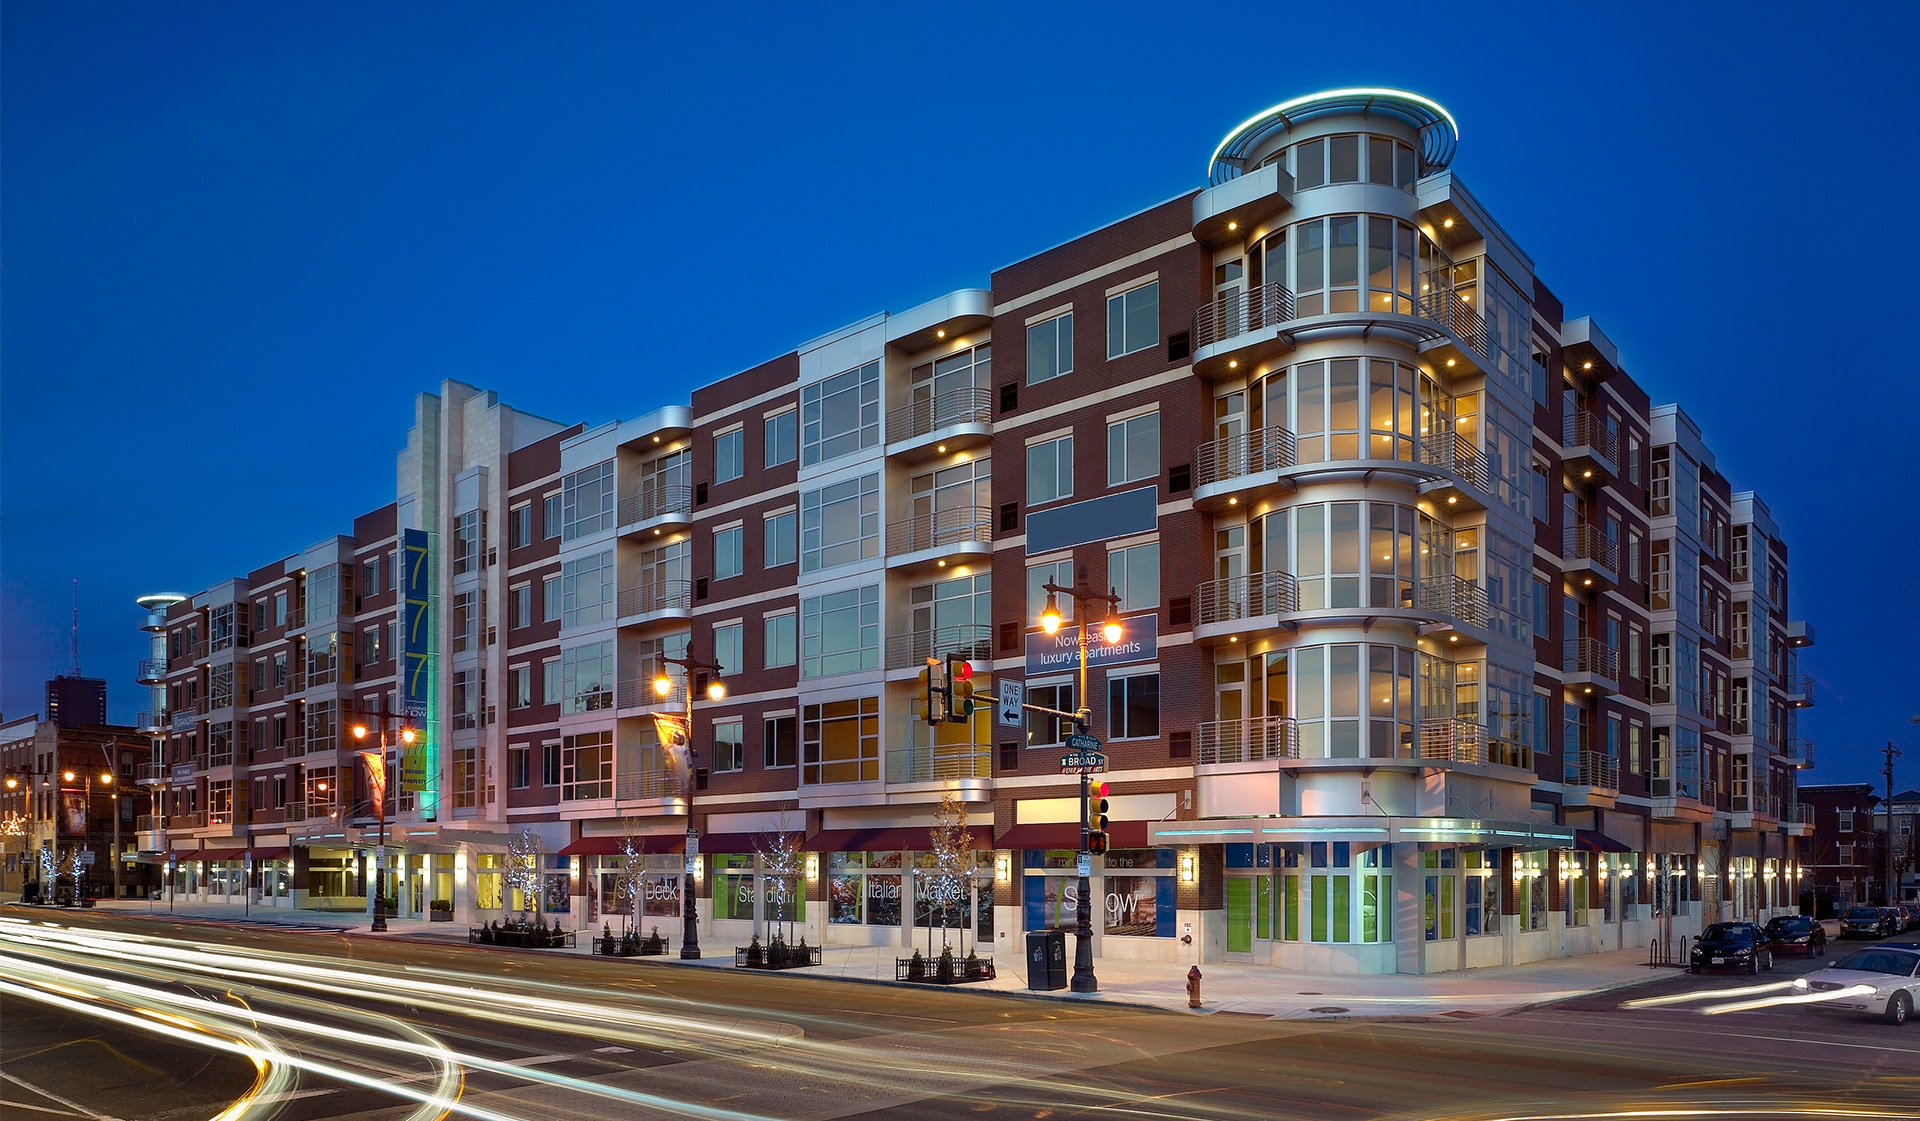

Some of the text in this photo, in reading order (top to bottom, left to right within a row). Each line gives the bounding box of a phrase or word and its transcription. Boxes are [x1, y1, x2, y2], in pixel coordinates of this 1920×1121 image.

[1040, 650, 1072, 665] luxury
[1004, 683, 1019, 696] ONE
[1003, 696, 1019, 707] WAY
[404, 709, 427, 717] NOW
[1071, 737, 1098, 750] CATHARINE
[1068, 757, 1097, 766] BROAD
[1108, 858, 1134, 867] to the
[1063, 886, 1138, 912] Sow
